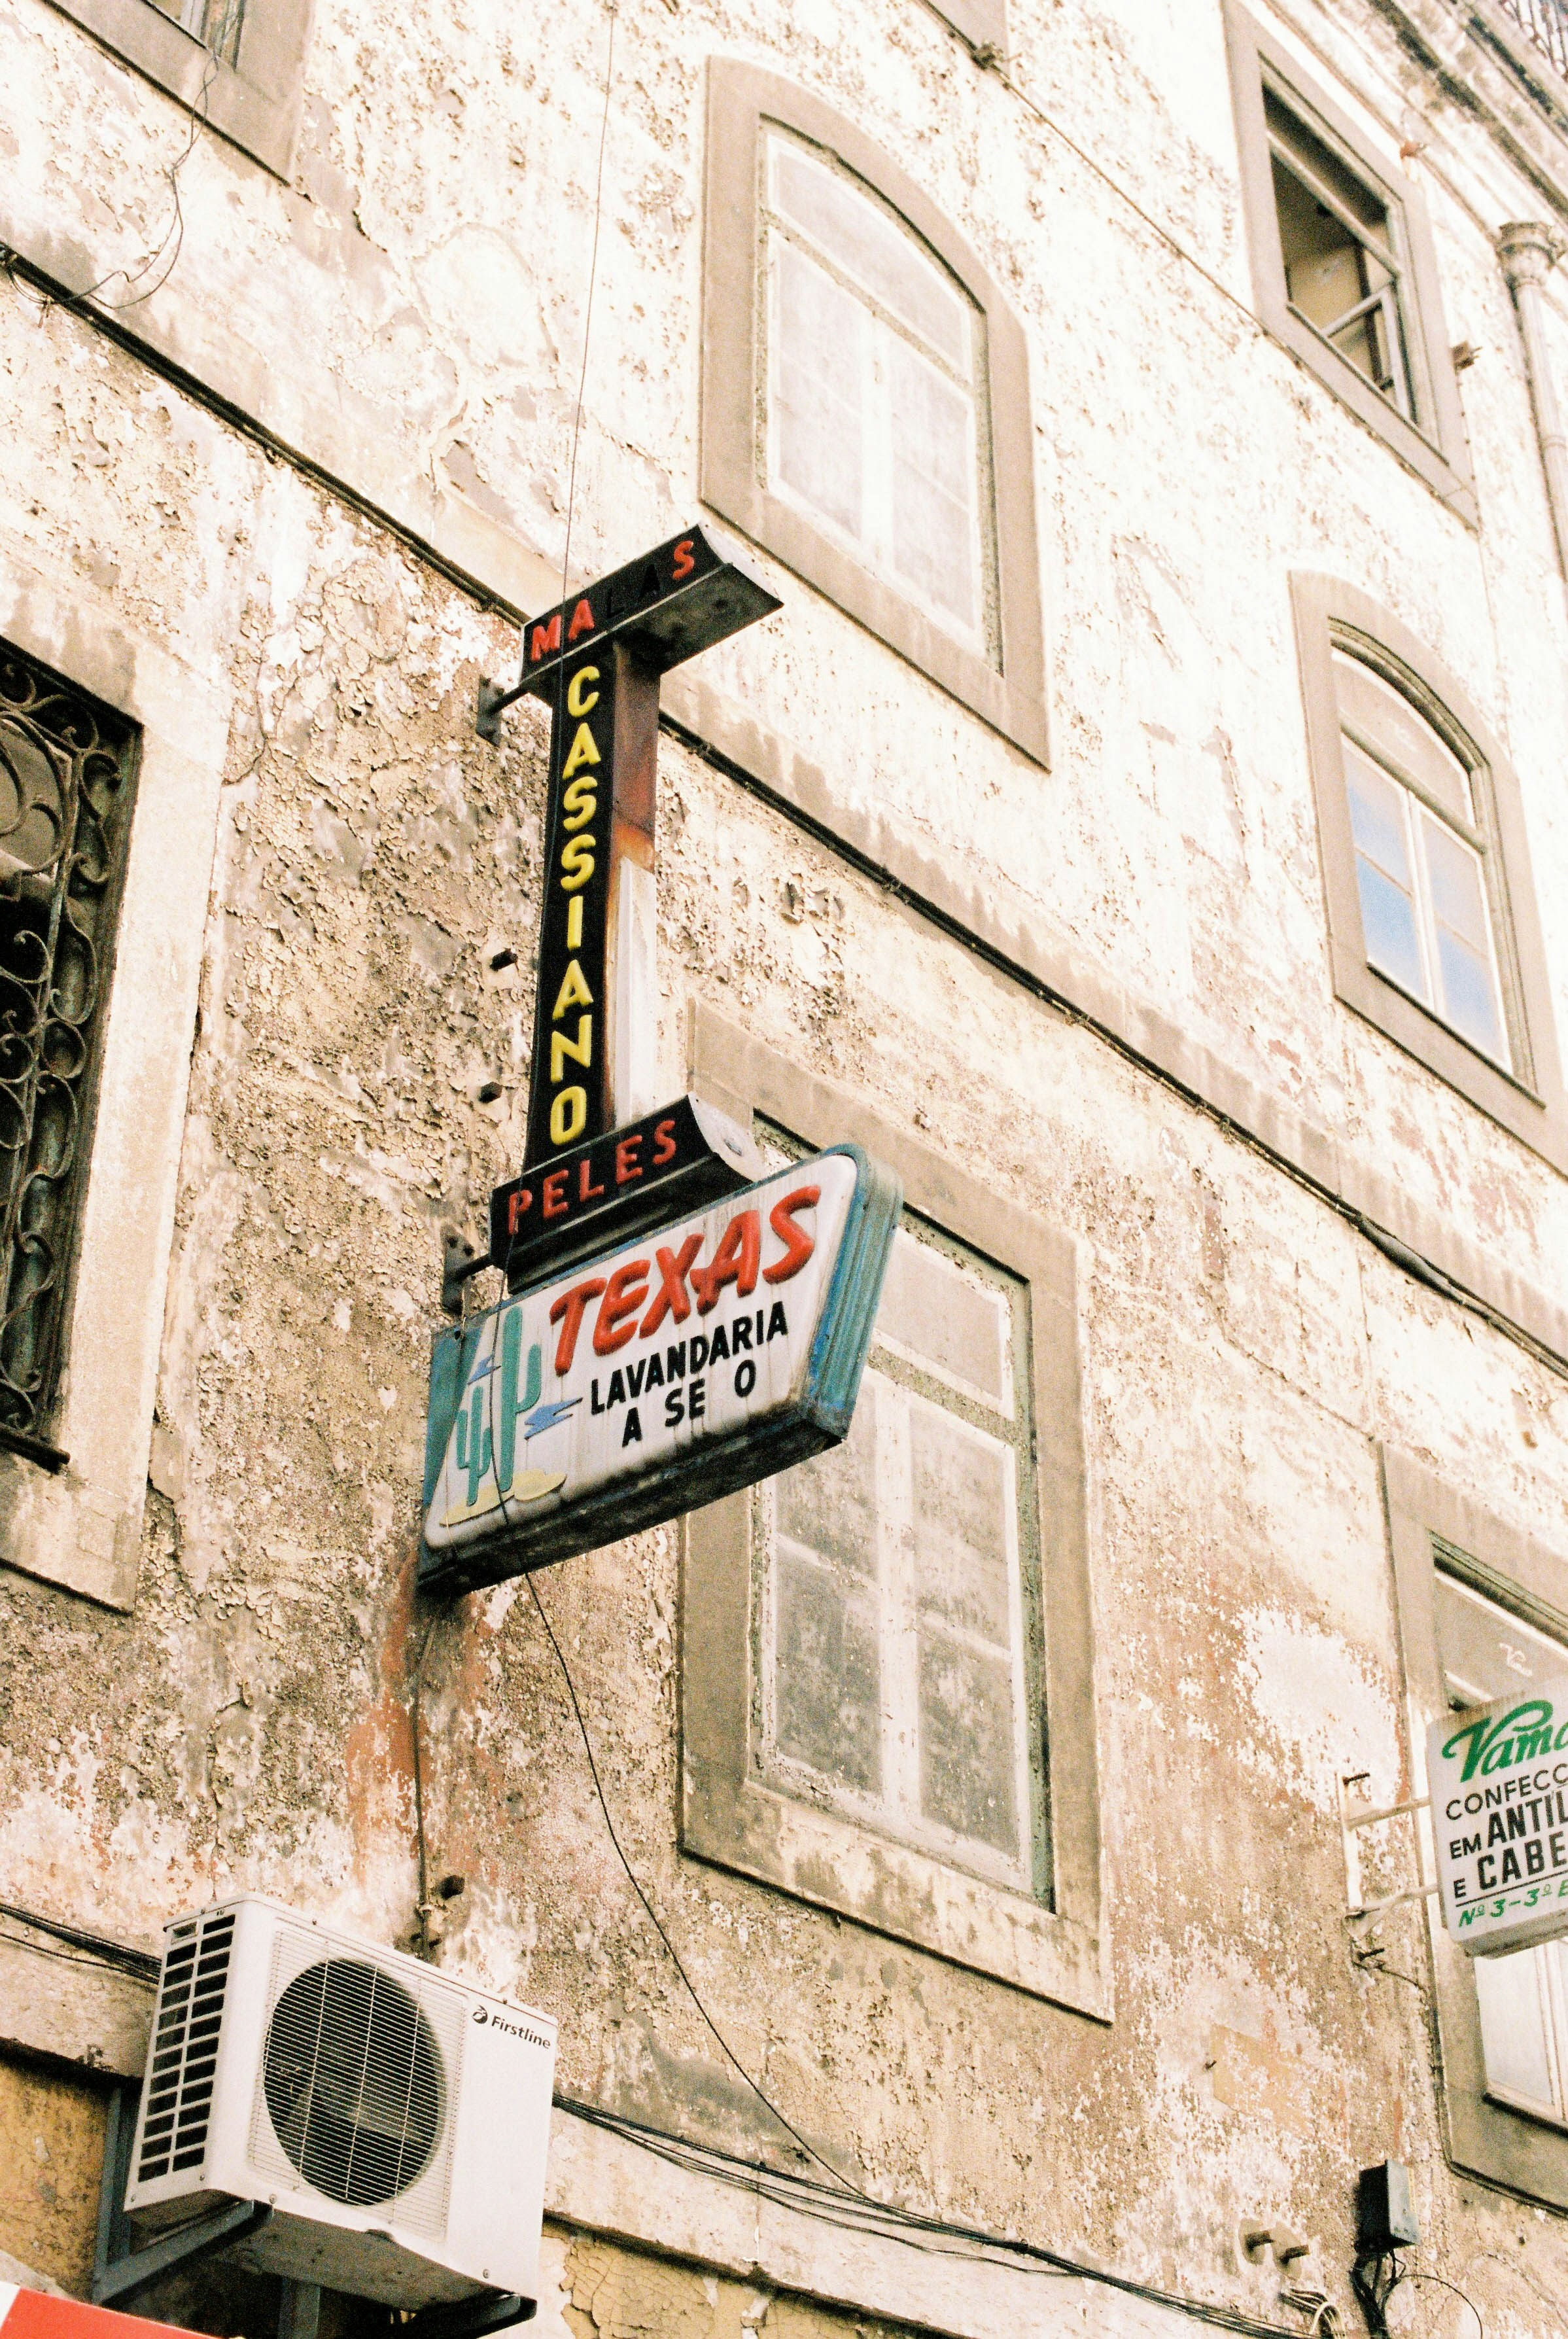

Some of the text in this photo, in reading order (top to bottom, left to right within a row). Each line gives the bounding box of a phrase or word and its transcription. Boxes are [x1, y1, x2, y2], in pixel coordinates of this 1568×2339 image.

[531, 540, 695, 661] MALAS
[550, 665, 601, 1145] CASSIANO
[508, 1120, 676, 1235] PELES
[549, 1186, 820, 1375] TEXAS
[591, 1301, 788, 1415] LAVANDARIA
[622, 1407, 643, 1447] A
[1450, 1833, 1482, 1859] EM
[1454, 1831, 1567, 1899] E CABE
[491, 2015, 551, 2049] Firstline
